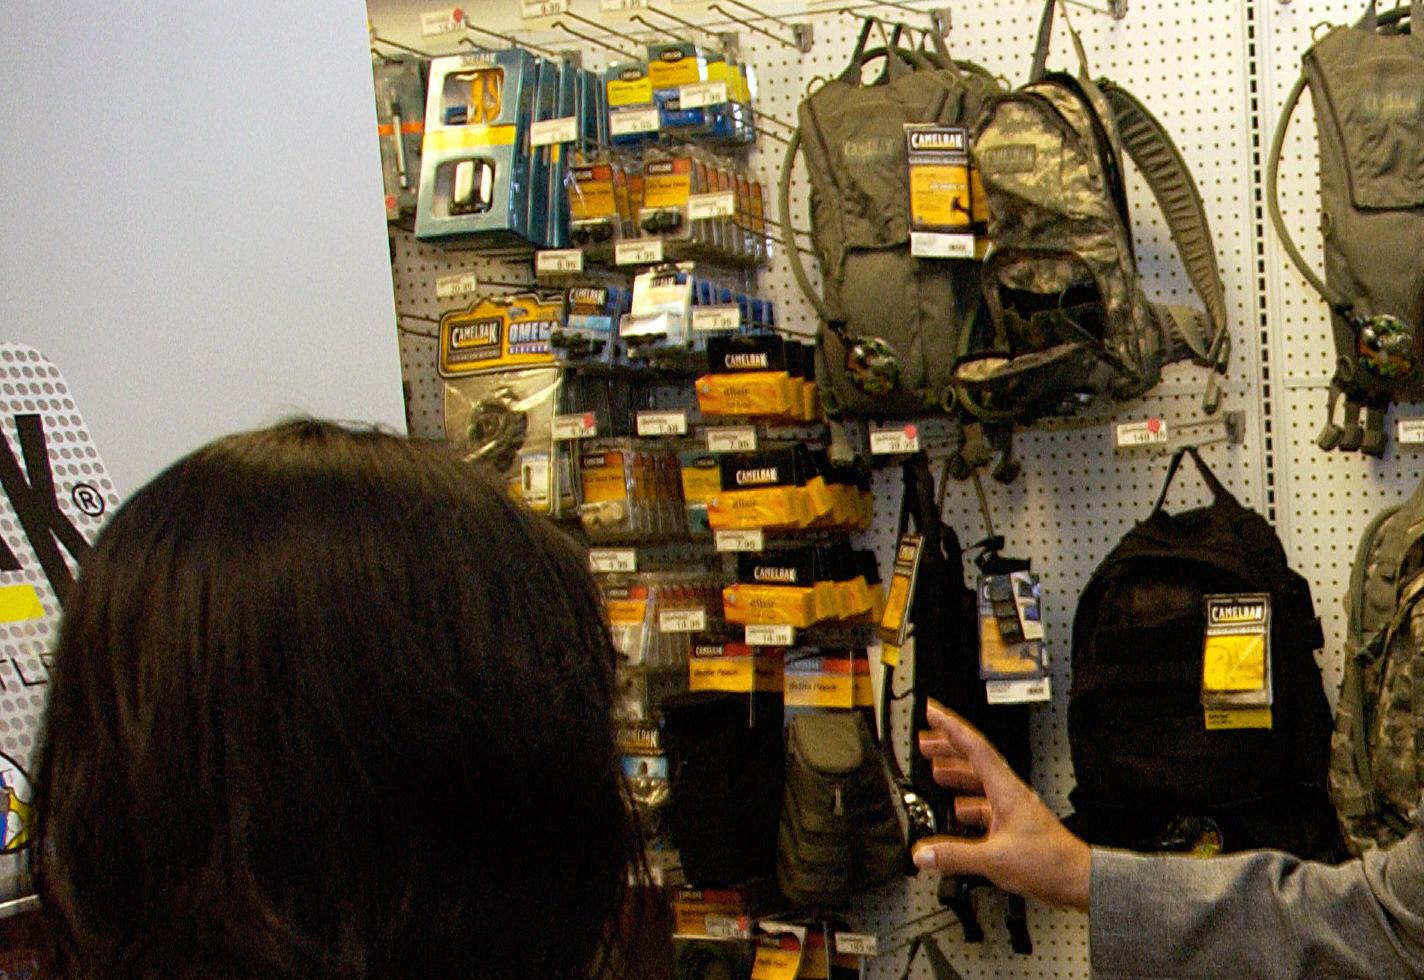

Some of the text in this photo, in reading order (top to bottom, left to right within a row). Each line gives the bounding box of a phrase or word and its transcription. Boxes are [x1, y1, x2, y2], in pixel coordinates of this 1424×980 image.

[911, 132, 963, 150] CAMELBAK
[452, 321, 558, 348] CAMELBAK OMEGA
[725, 352, 768, 369] CAMELBAK
[736, 467, 778, 485] CAMELBAK
[754, 566, 797, 583] CAMELBAK
[1211, 605, 1263, 622] CAMELBAK
